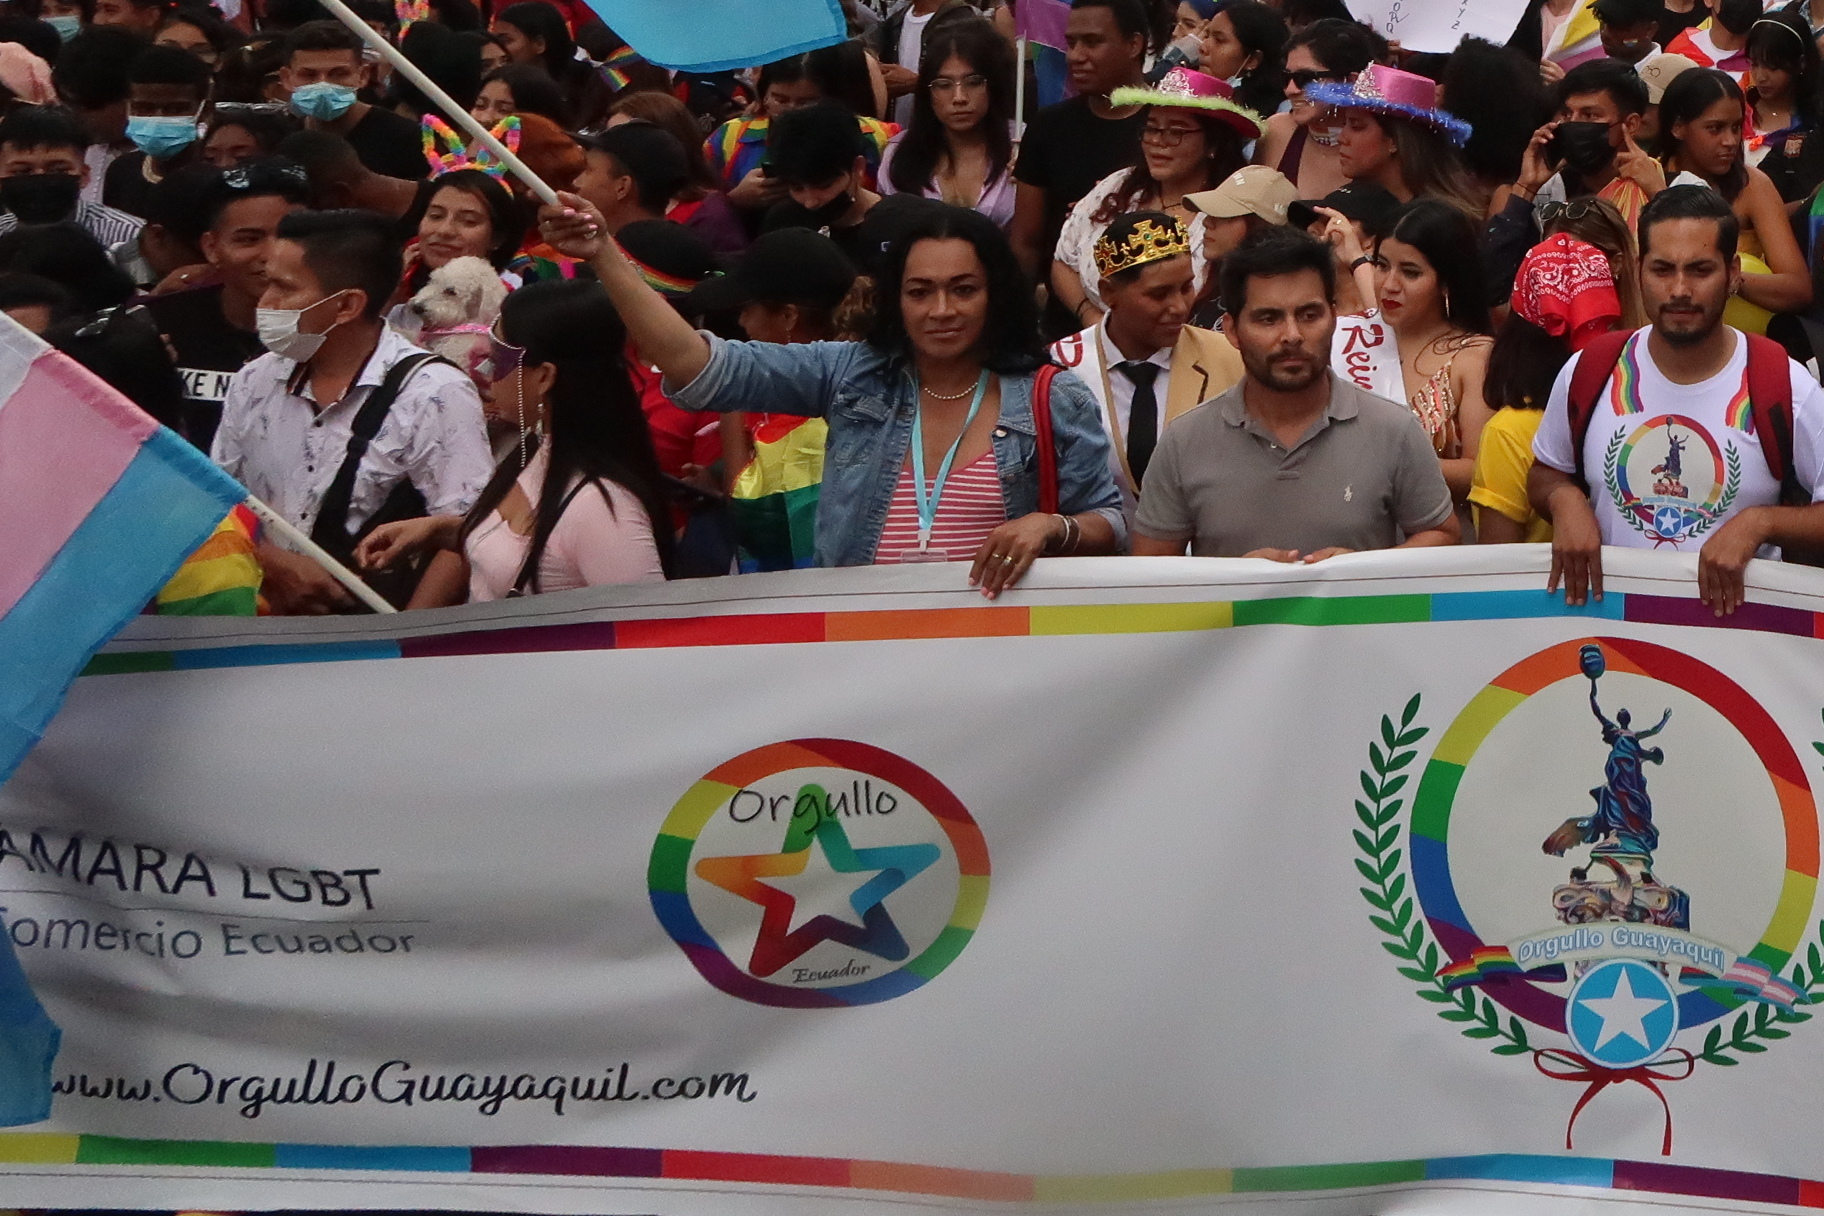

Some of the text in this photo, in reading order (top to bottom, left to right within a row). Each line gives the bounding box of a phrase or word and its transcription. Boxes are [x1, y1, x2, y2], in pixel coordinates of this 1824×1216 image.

[729, 780, 898, 835] Orgullo
[239, 862, 381, 910] LGBT
[0, 906, 415, 959] omercio Ecuador
[1519, 925, 1725, 972] Orgullo Guayaquil
[792, 959, 871, 984] Ecuador
[52, 1058, 757, 1119] www.OrgulloGuayaquil.com
